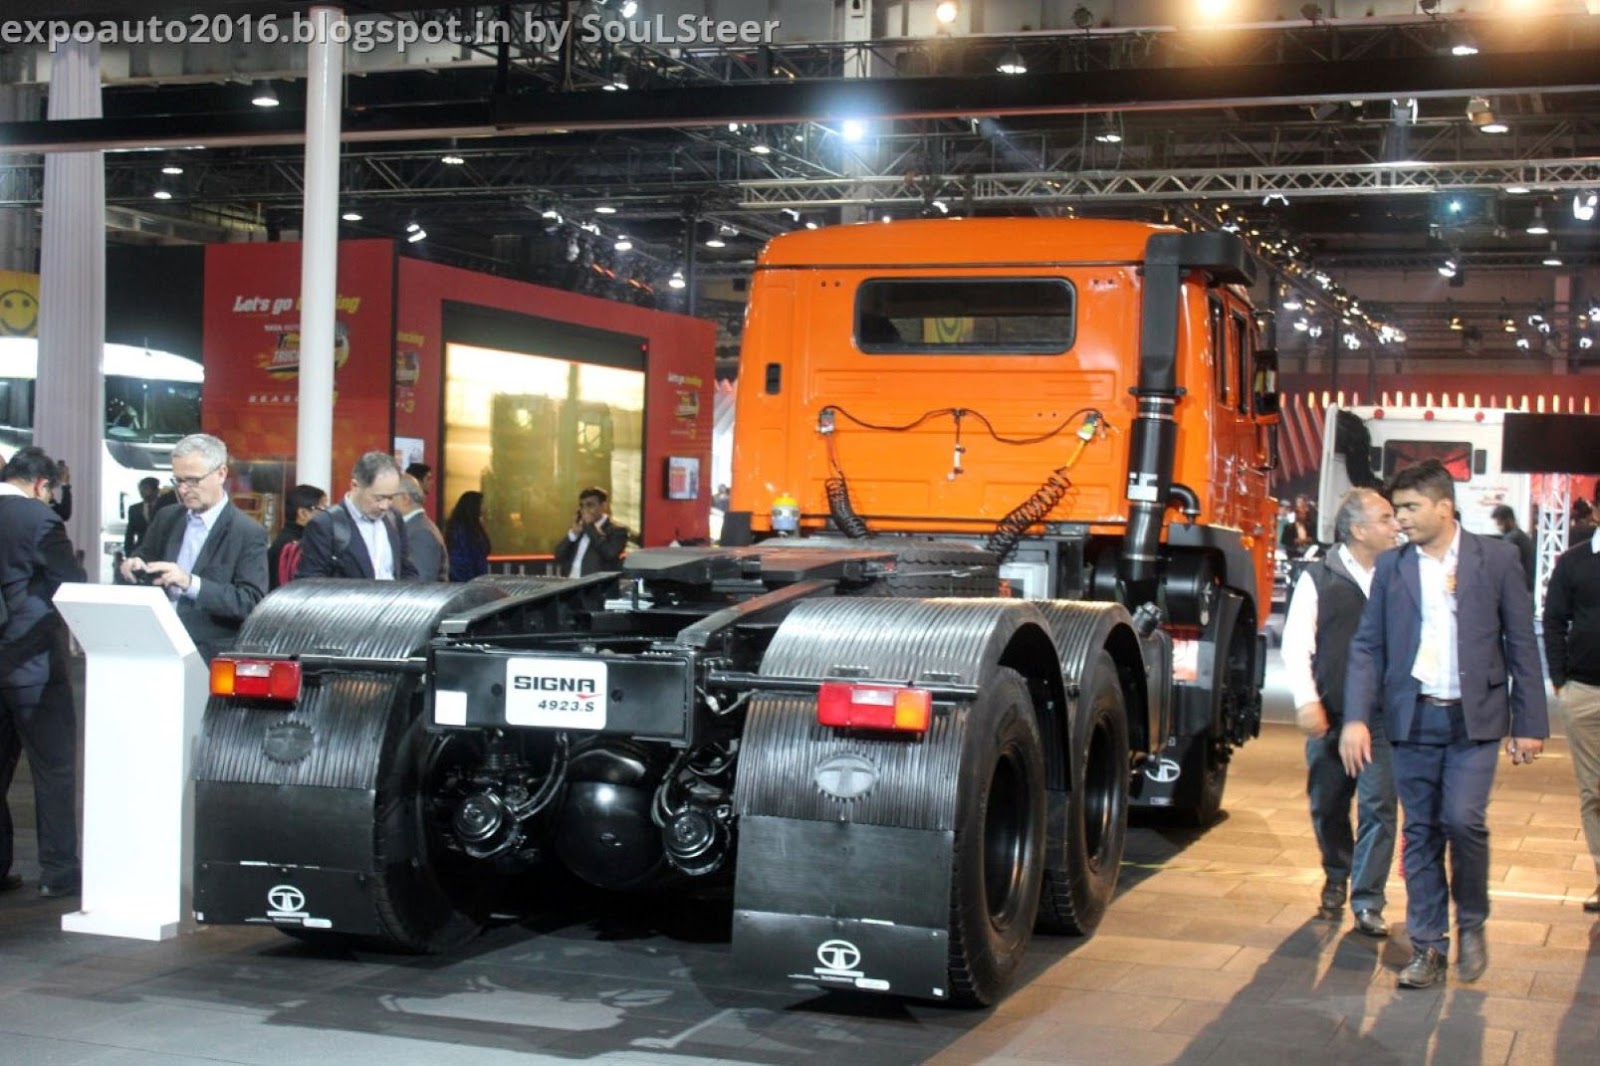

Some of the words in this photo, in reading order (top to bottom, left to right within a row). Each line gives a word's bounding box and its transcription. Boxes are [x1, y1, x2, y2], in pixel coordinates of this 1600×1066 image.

[233, 295, 271, 313] Let's
[272, 297, 293, 315] go
[514, 675, 595, 693] SIGNA
[538, 700, 595, 712] 4923.S
